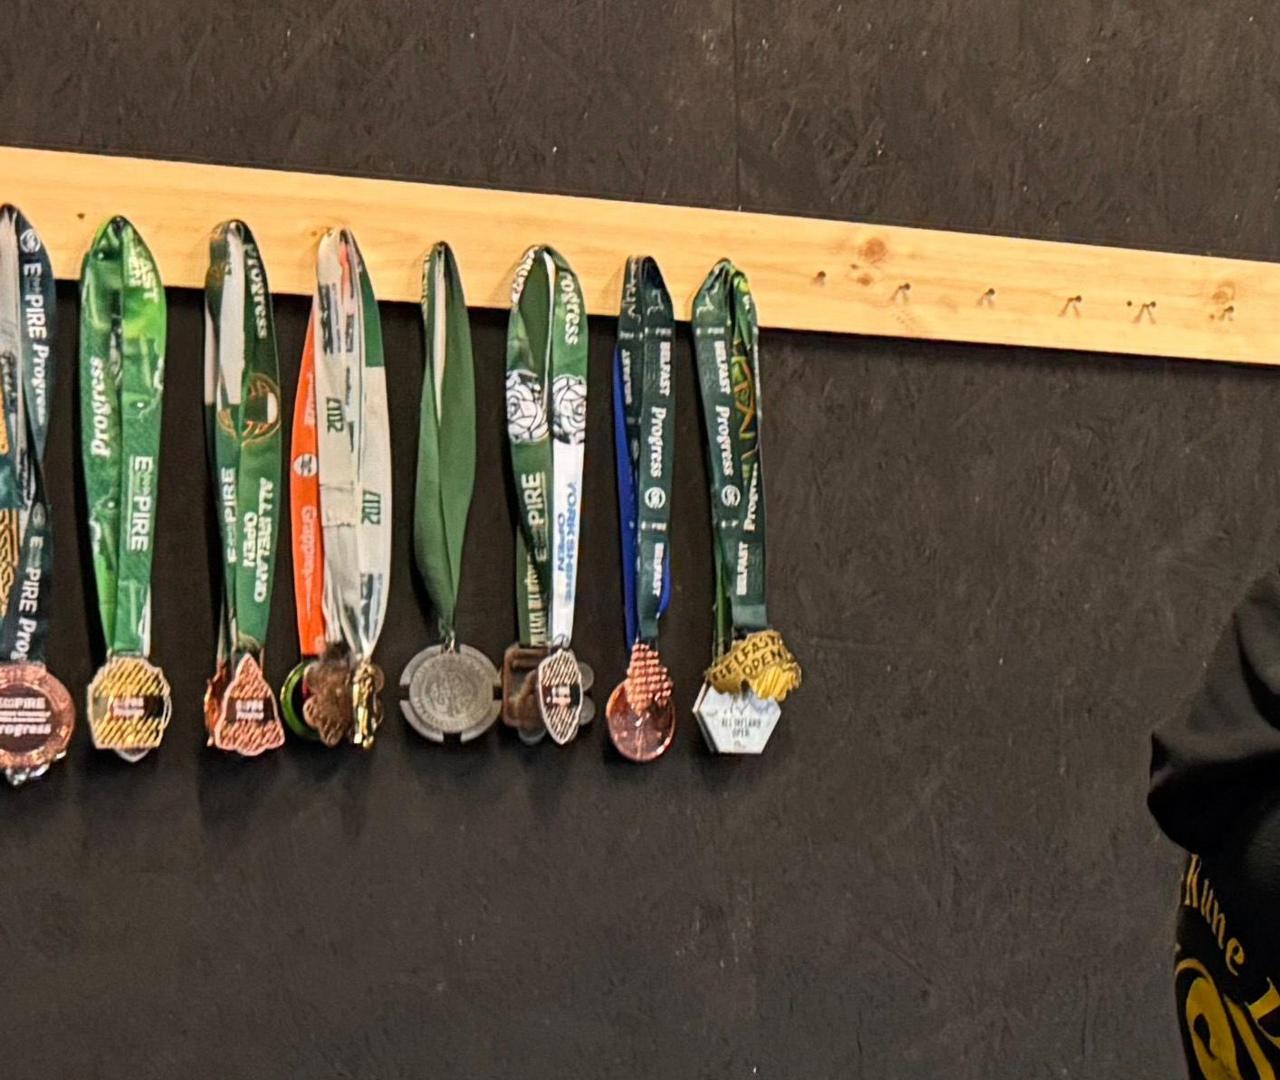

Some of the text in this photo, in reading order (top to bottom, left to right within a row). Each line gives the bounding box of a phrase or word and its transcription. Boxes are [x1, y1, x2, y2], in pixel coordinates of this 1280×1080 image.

[559, 271, 581, 346] rogress
[90, 355, 112, 458] Progress
[648, 406, 667, 478] Progress
[716, 405, 734, 477] Progress
[243, 512, 258, 567] OPEN
[253, 477, 274, 603] ALL IRELAND
[557, 513, 566, 571] OPEN
[10, 615, 37, 662] Prog
[743, 648, 782, 677] OPEN
[0, 723, 52, 738] rogress
